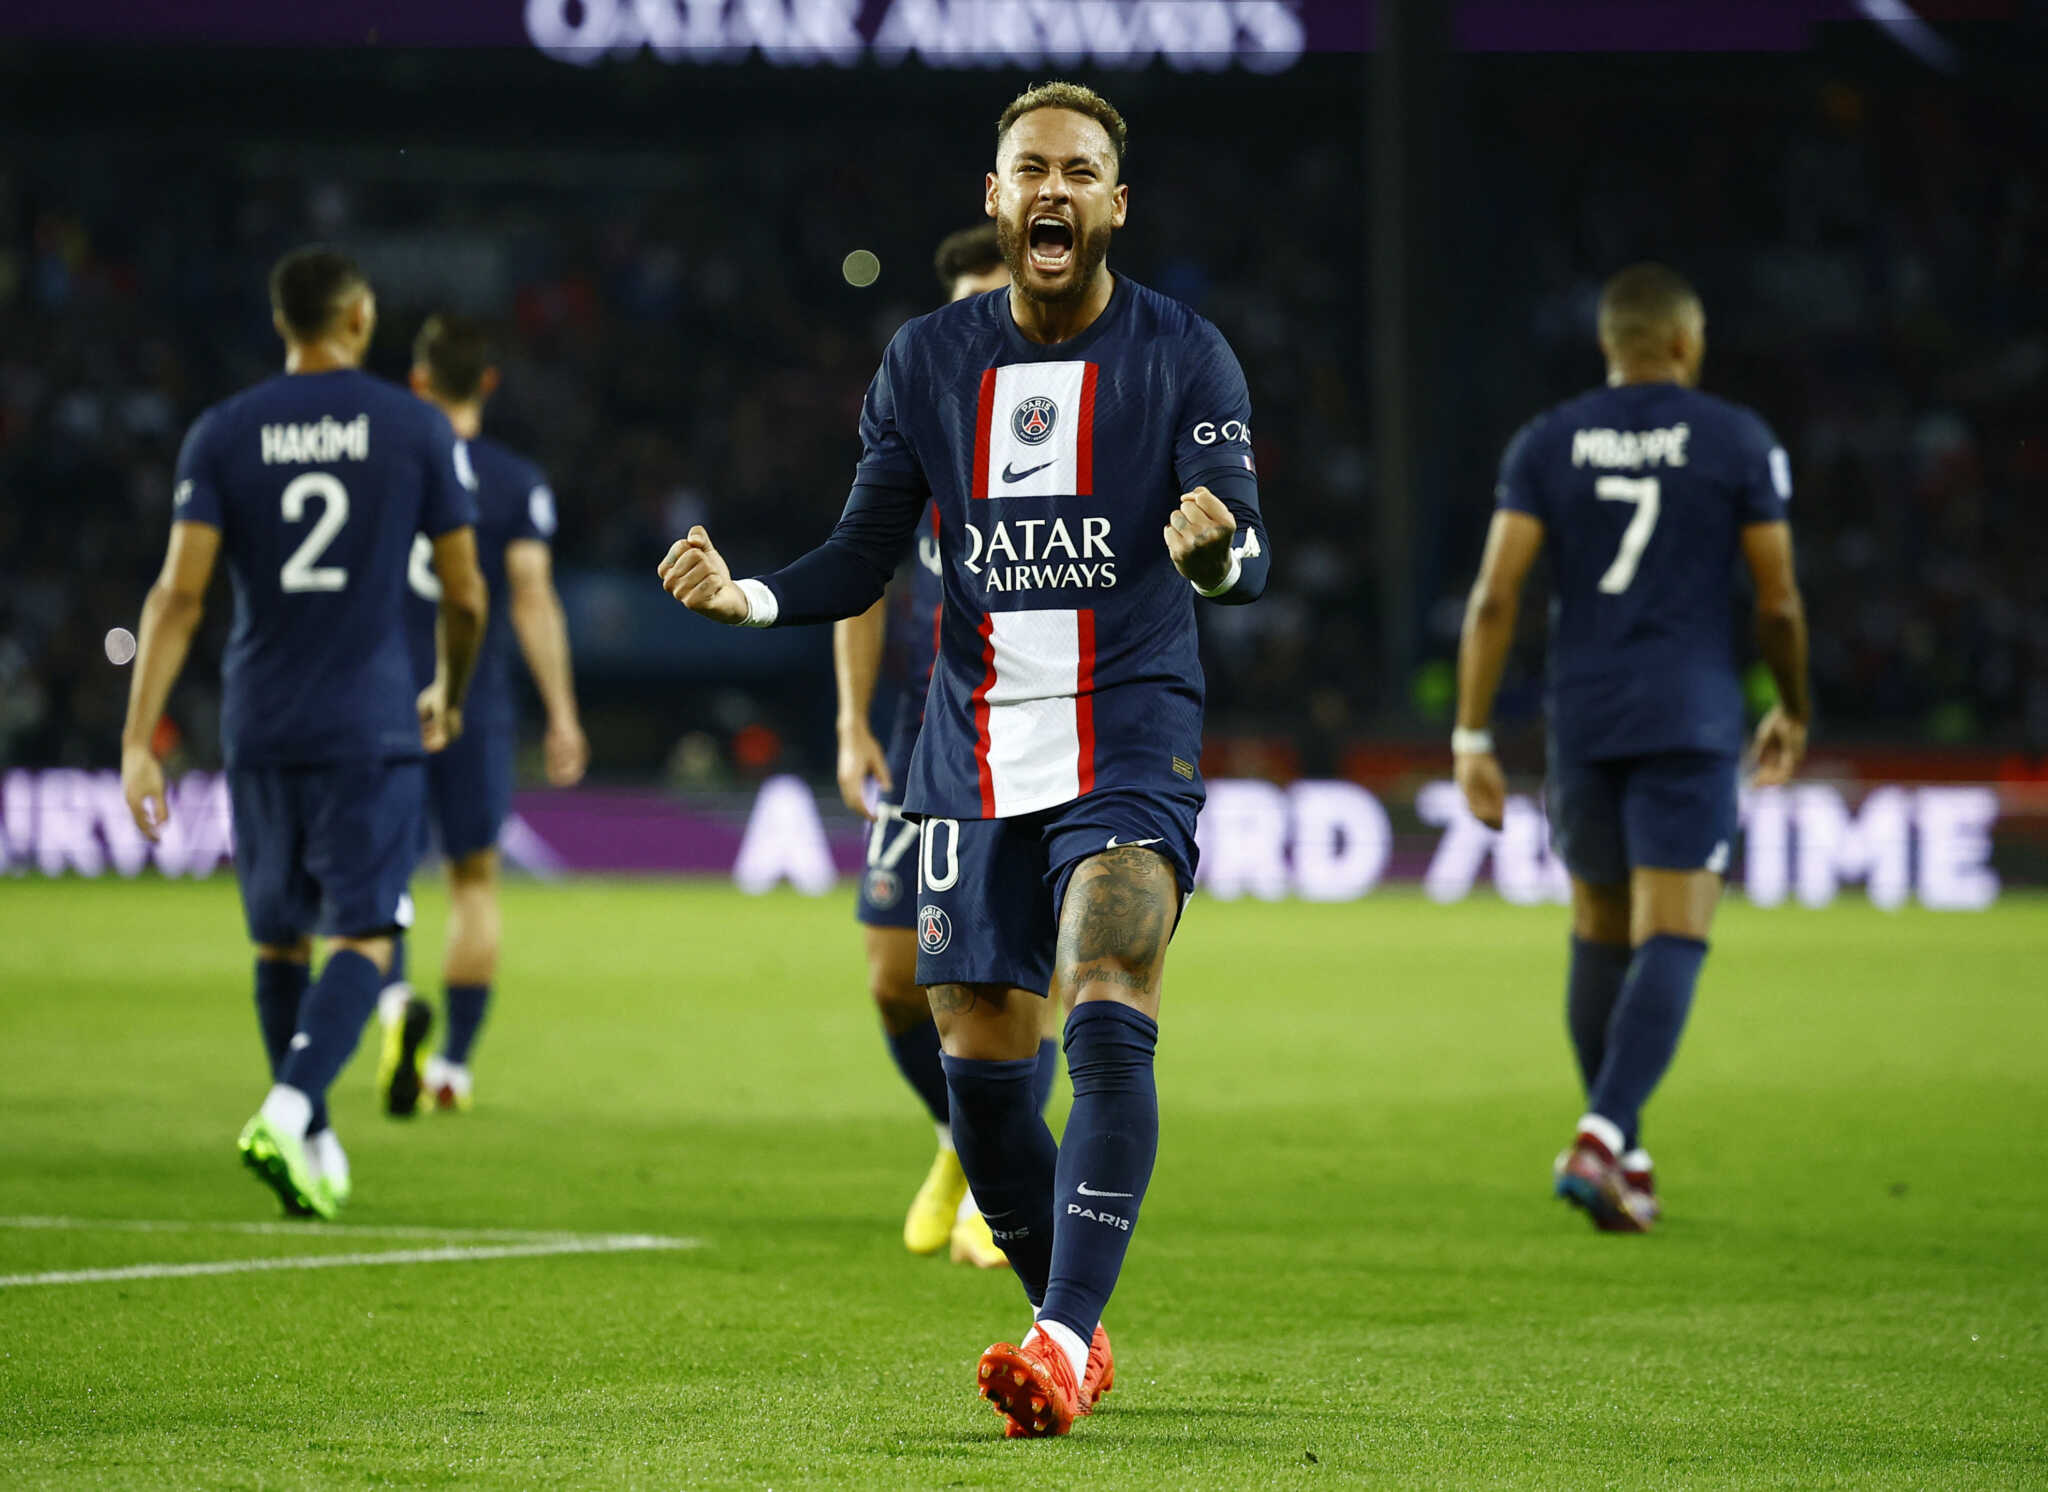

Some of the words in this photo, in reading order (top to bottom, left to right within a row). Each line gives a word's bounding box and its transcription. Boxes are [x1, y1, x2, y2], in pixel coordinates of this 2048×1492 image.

[1020, 400, 1052, 412] PARIS
[1193, 420, 1251, 446] GOA
[280, 471, 349, 594] 2
[1594, 475, 1661, 595] 7
[985, 562, 1118, 593] AIRWAYS
[734, 774, 840, 896] A
[1067, 1203, 1130, 1231] PARIS
